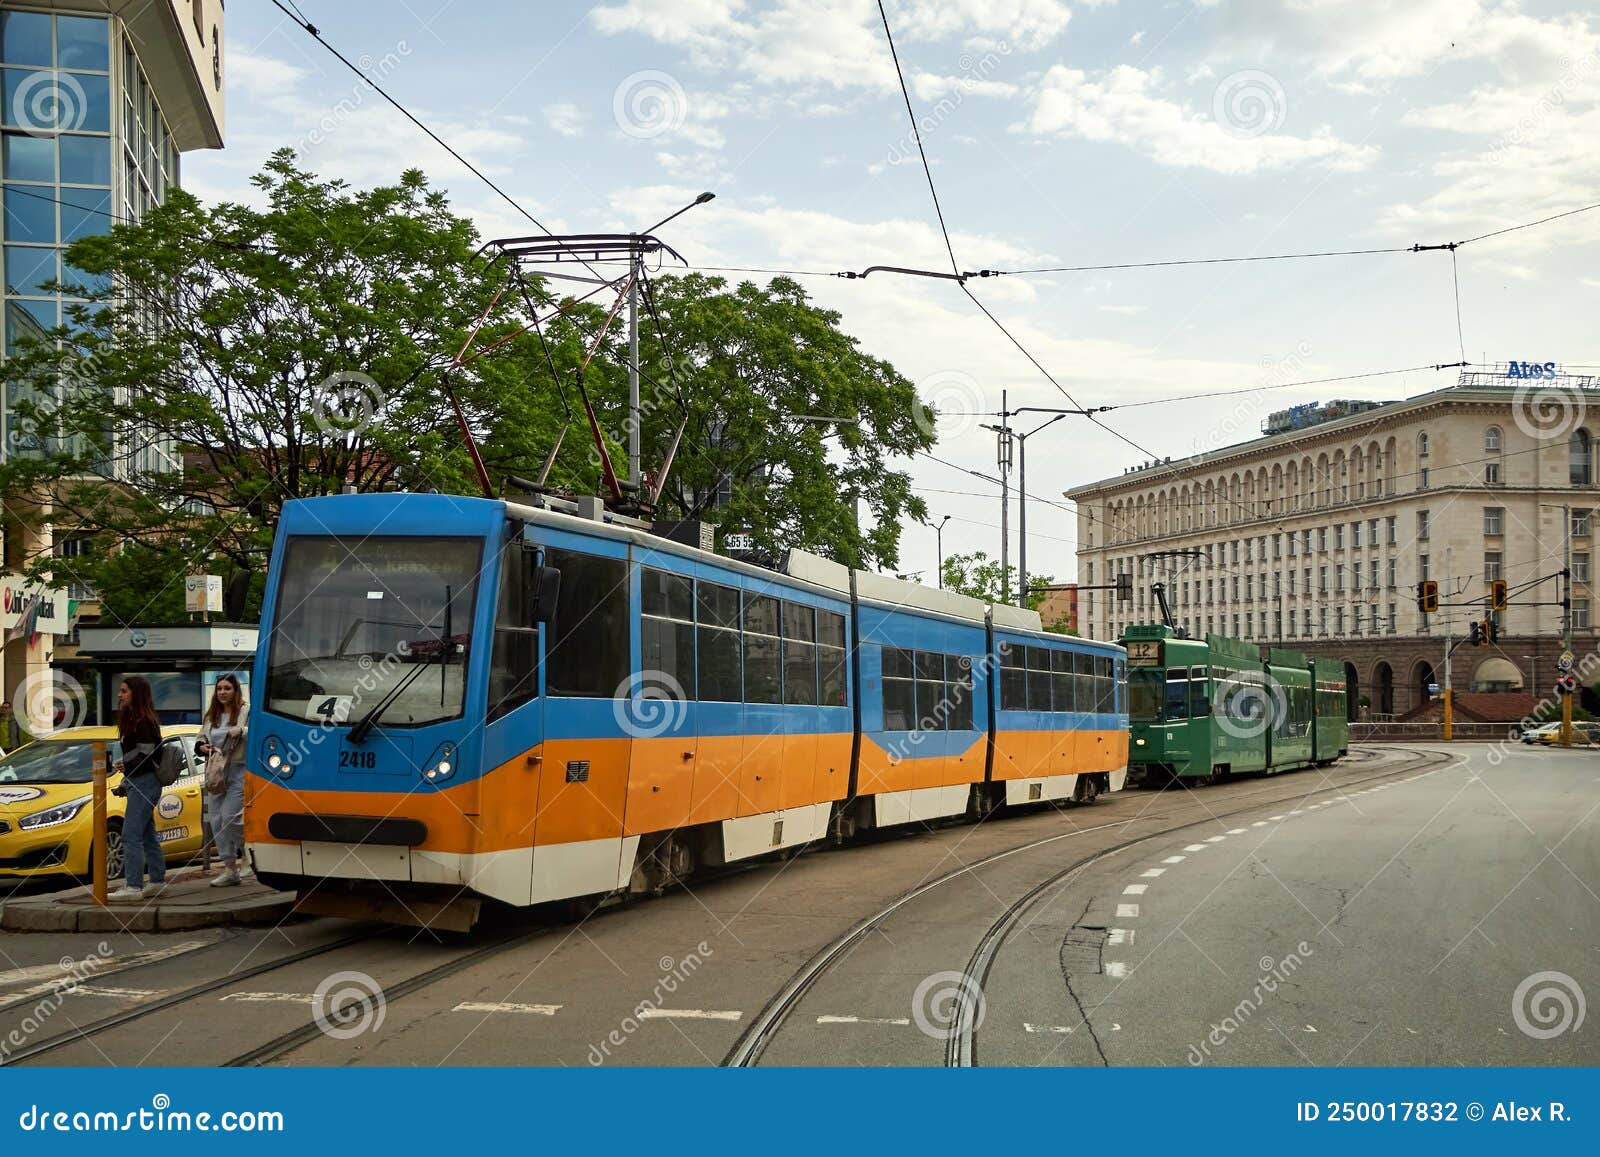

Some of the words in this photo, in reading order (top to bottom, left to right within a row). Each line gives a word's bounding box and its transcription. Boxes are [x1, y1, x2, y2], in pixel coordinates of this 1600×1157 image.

[1135, 643, 1150, 657] 12
[316, 697, 337, 719] 4
[340, 751, 376, 769] 2418
